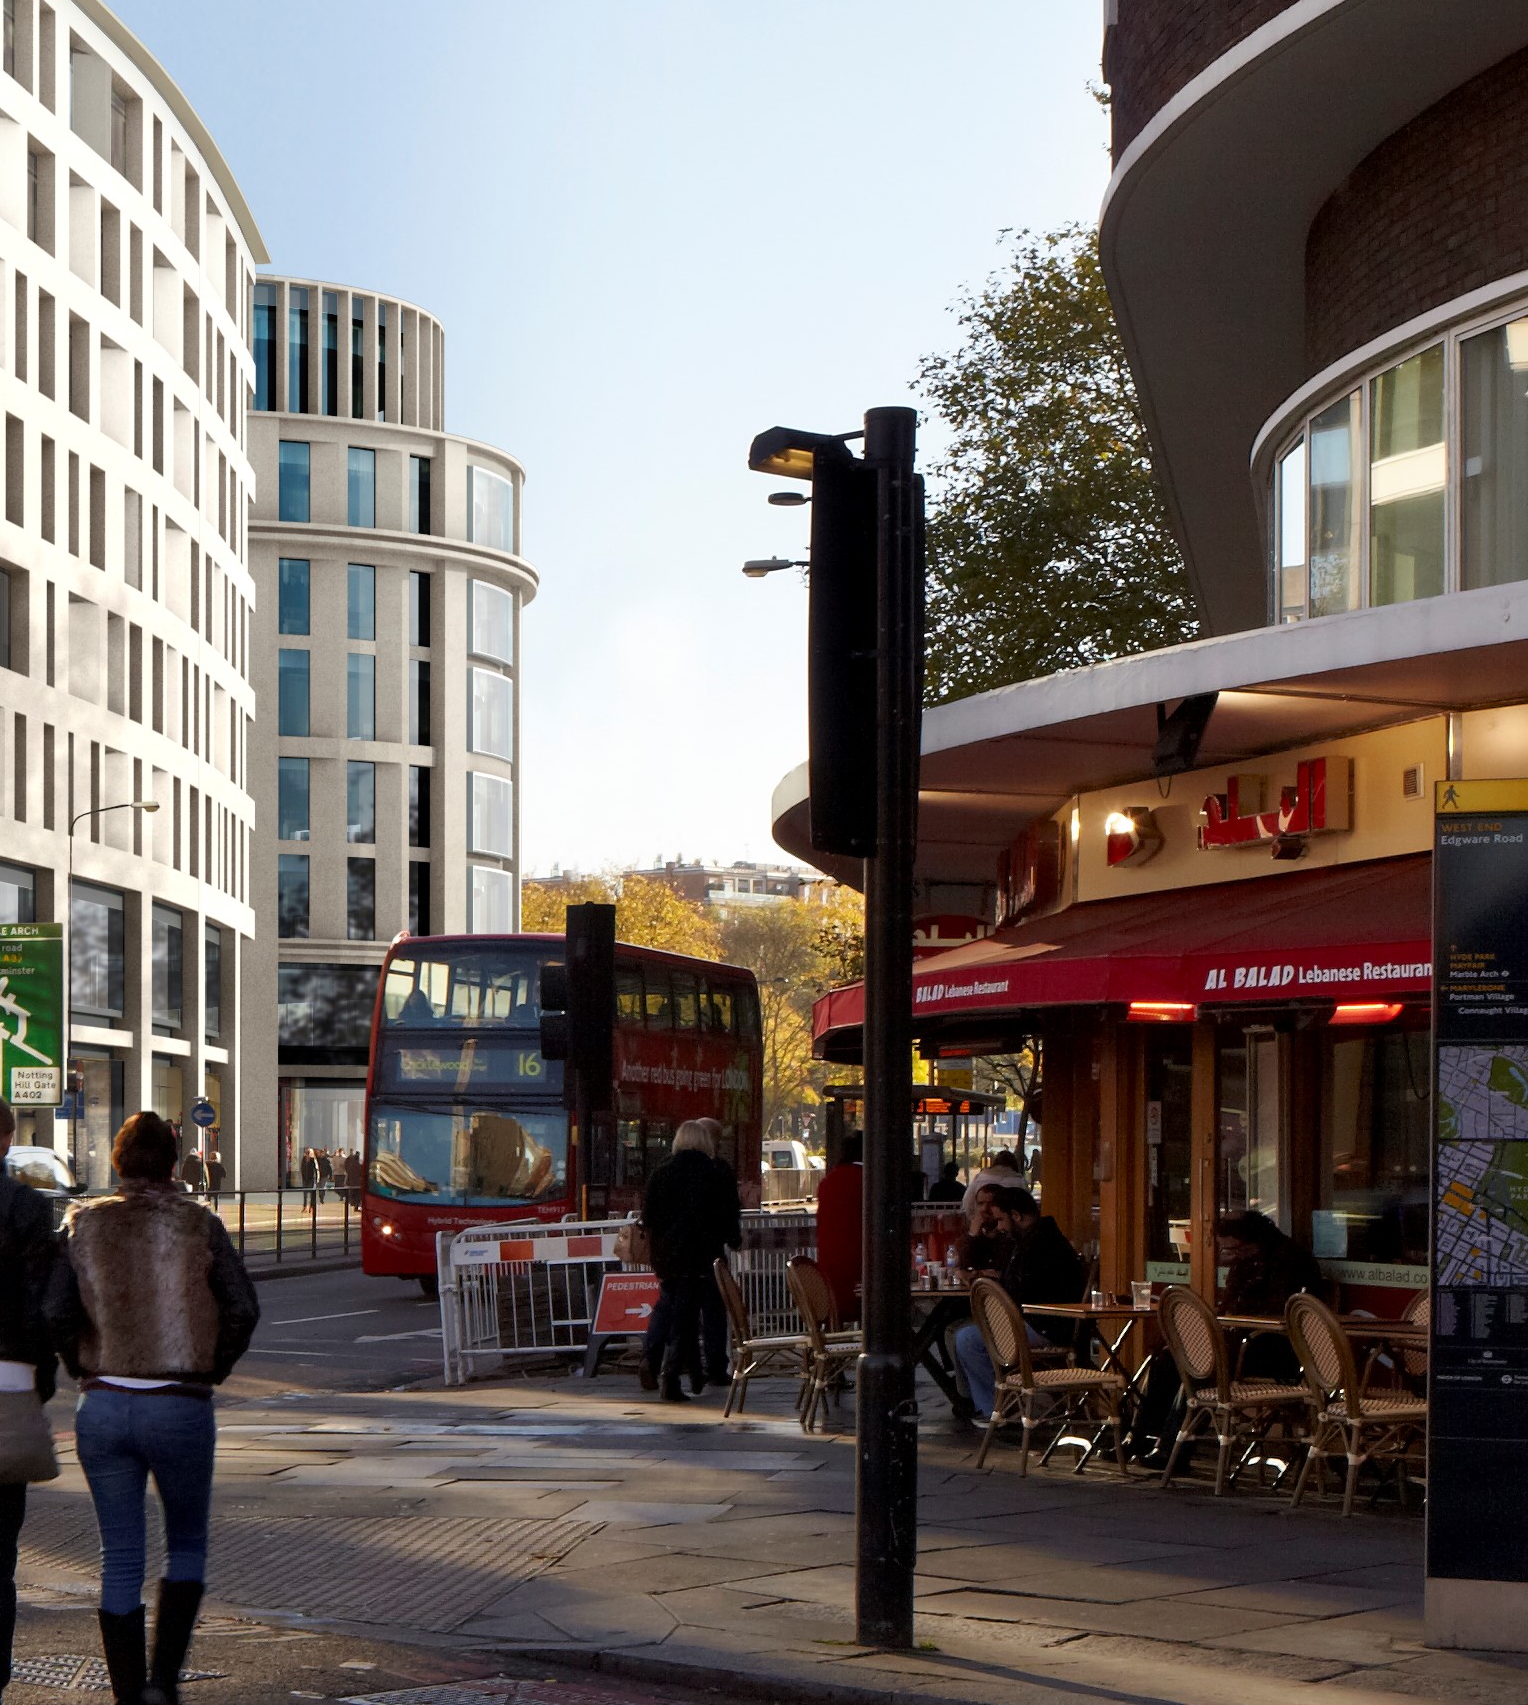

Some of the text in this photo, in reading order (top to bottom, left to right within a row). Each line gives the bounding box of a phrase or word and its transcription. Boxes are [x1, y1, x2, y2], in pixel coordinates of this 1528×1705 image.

[1441, 822, 1472, 833] WEST
[1441, 833, 1524, 847] Edgware Road
[10, 926, 39, 936] ARCH
[1, 943, 23, 952] road
[1204, 961, 1433, 990] AL BALAD Lebanese Restauran
[1479, 970, 1500, 978] Arch
[916, 980, 1009, 1004] BALAD Lebanese Restaurant
[1486, 993, 1515, 1002] Village
[1504, 1006, 1528, 1016] Villag
[518, 1052, 542, 1077] 16
[17, 1071, 54, 1081] Notting
[621, 1060, 650, 1083] Another
[650, 1063, 663, 1084] red
[663, 1063, 675, 1085] bus
[675, 1066, 693, 1091] going
[693, 1070, 711, 1093] green
[15, 1080, 57, 1090] Hill Gate
[14, 1091, 42, 1100] A402
[427, 1217, 452, 1226] Hybrid
[606, 1280, 660, 1291] PEDESTRIAN
